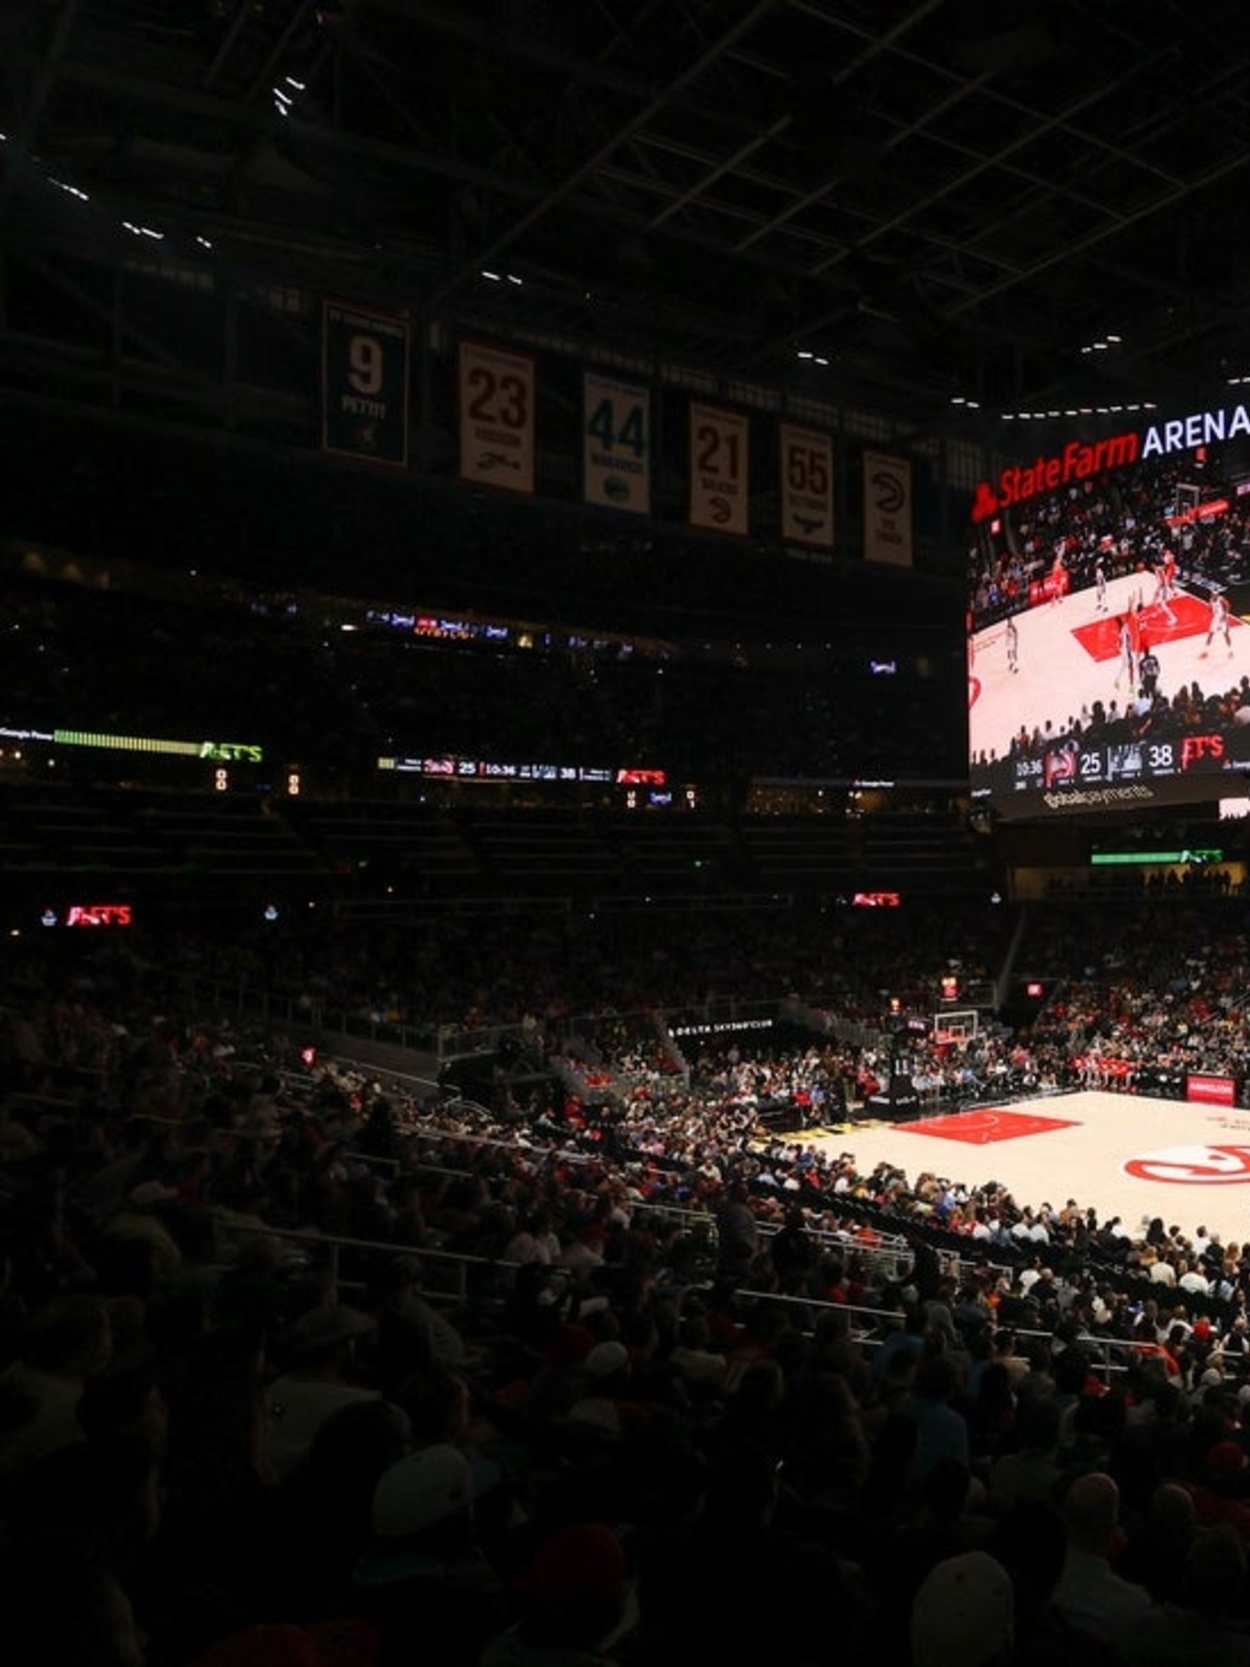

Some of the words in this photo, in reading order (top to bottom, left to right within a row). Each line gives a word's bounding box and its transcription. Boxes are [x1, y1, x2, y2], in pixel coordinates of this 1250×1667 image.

[348, 334, 383, 395] 9
[469, 369, 527, 428] 23
[589, 398, 643, 458] 44
[699, 425, 738, 479] 21
[788, 445, 828, 495] 55
[459, 762, 475, 774] 25
[1081, 752, 1101, 774] 25
[1149, 744, 1173, 767] 38
